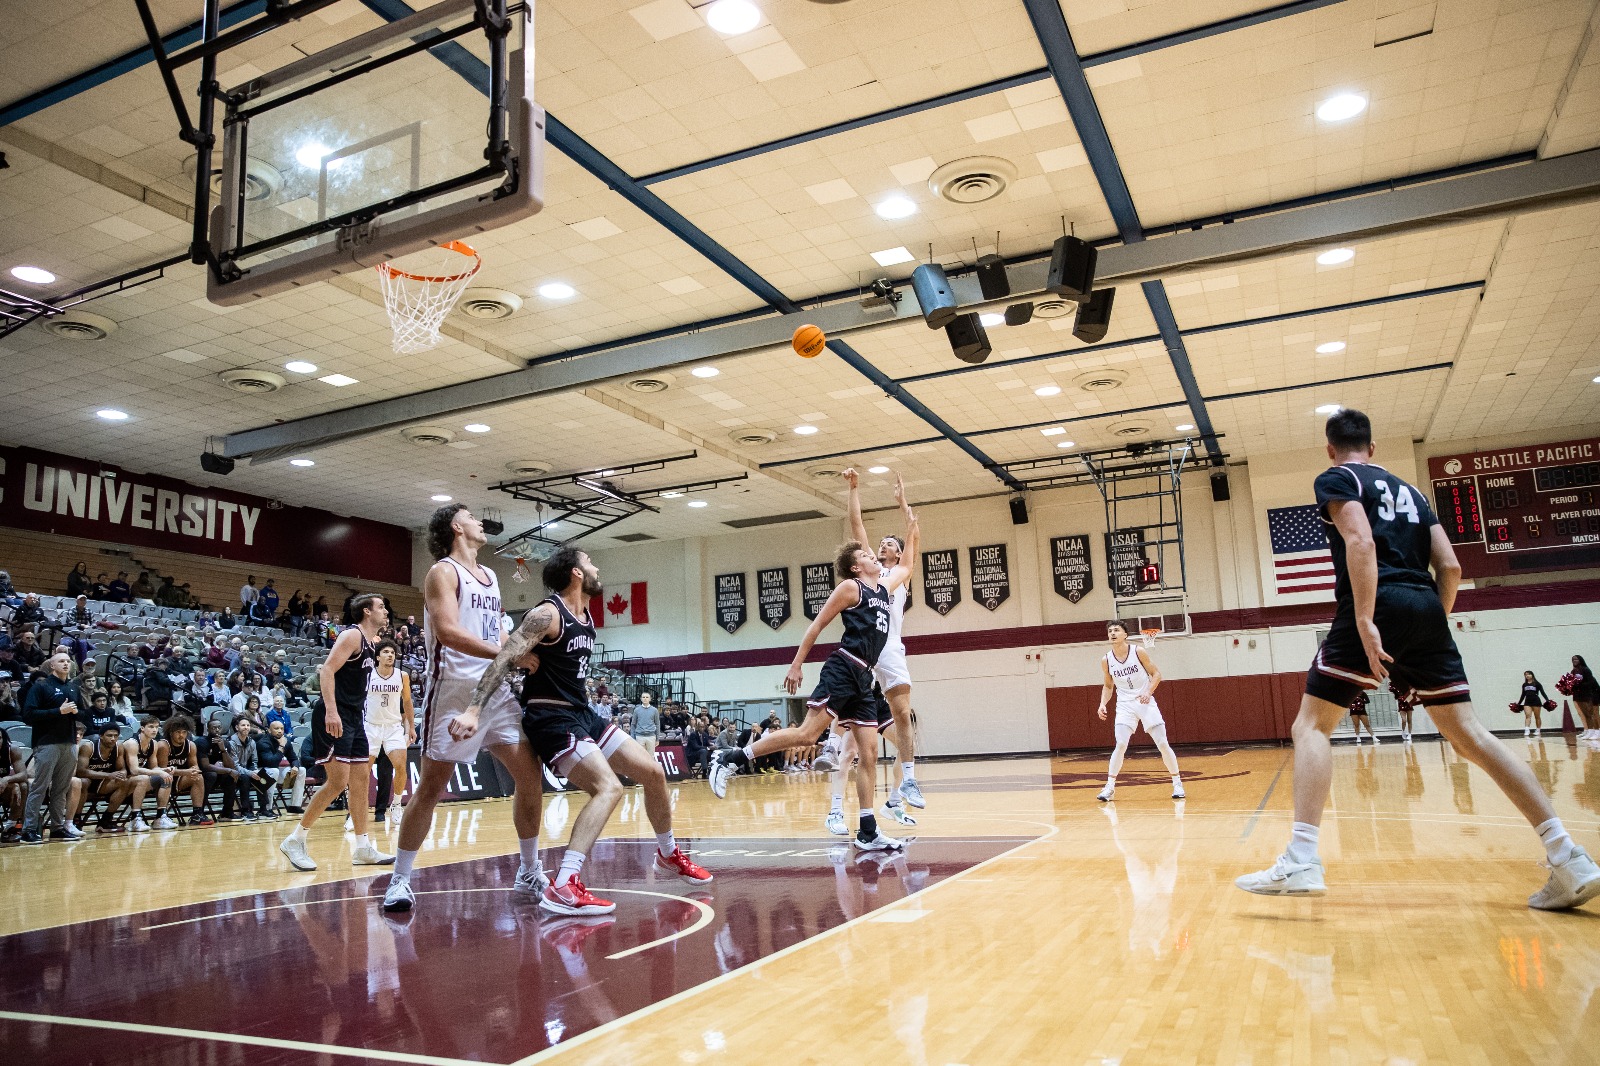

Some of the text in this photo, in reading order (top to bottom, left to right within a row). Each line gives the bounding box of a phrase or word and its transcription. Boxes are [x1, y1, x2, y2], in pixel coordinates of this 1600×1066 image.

[1474, 444, 1593, 470] SEATTLE PACIFIC
[1486, 476, 1515, 488] HOME
[1468, 486, 1475, 494] 2
[24, 462, 261, 546] UNIVERSITY
[1374, 480, 1420, 524] 34
[1550, 495, 1578, 504] PERIOD
[1471, 505, 1477, 513] 2
[1550, 508, 1600, 520] PLAYER FOUL
[1488, 518, 1508, 526] FOULS
[1522, 514, 1543, 523] T.O.L.
[1497, 526, 1508, 540] 0
[1529, 524, 1540, 536] 4
[1572, 534, 1600, 543] MATCH
[1056, 538, 1084, 552] NCAA
[1490, 542, 1514, 551] SCORE
[976, 547, 1000, 560] USGF
[1112, 552, 1141, 561] NATIONAL
[928, 552, 952, 566] NCAA
[1058, 556, 1085, 566] NATIONAL
[806, 566, 829, 578] NCAA
[976, 566, 1004, 574] NATIONAL
[1055, 564, 1090, 574] CHAMPIONS
[1144, 566, 1157, 581] 17
[762, 570, 784, 582] NCAA
[928, 570, 954, 580] NATIONAL
[974, 572, 1006, 582] CHAMPIONS
[720, 576, 740, 588] NCAA
[926, 578, 958, 588] CHAMPIONS
[1064, 579, 1084, 591] 1993
[1118, 576, 1135, 586] 199
[762, 588, 786, 596] NATIONAL
[806, 584, 830, 592] NATIONAL
[982, 588, 1000, 598] 1992
[720, 592, 742, 600] NATIONAL
[760, 594, 788, 604] CHAMPIONS
[934, 592, 952, 602] 1986
[471, 594, 500, 611] FALCON
[718, 598, 744, 608] CHAMPIONS
[766, 608, 782, 618] 1983
[812, 604, 824, 614] 198
[724, 612, 738, 622] 1978
[876, 610, 888, 634] 25
[482, 614, 500, 642] 14
[566, 635, 594, 652] COUGAR
[1114, 664, 1139, 678] FALCONS
[372, 684, 400, 692] FALCONS
[1126, 676, 1134, 690] 1
[380, 694, 390, 708] 3
